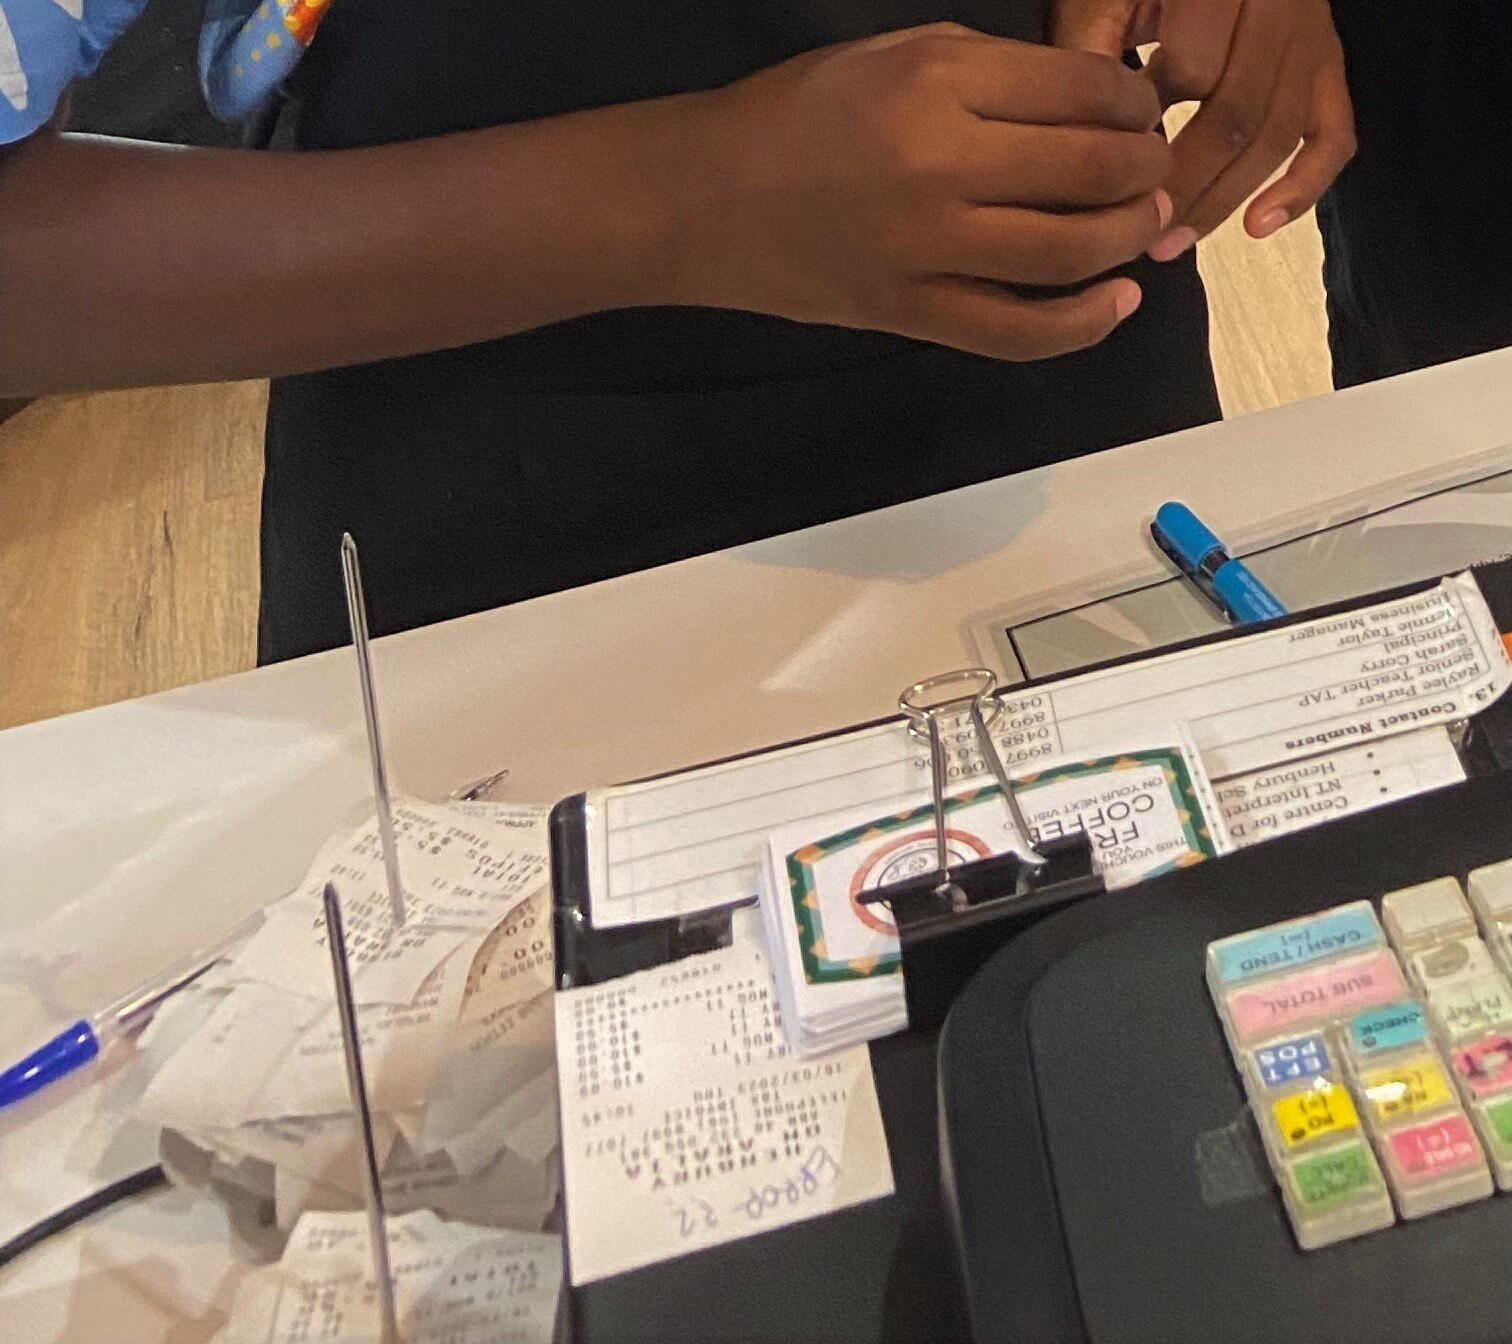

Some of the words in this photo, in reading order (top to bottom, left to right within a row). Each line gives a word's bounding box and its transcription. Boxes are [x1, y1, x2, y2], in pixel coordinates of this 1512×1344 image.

[1287, 618, 1365, 642] Manager
[1339, 622, 1394, 646] Taylor
[1384, 621, 1466, 654] Principal
[1360, 650, 1410, 672] Corry
[1342, 668, 1414, 696] Teacher
[1419, 662, 1480, 690] Raylee
[1298, 690, 1336, 706] TAP
[1356, 682, 1416, 706] Parker
[1380, 702, 1456, 728] Contact
[1286, 724, 1372, 749] Numbers
[1142, 775, 1164, 792] ON
[1254, 762, 1336, 790] Henbury
[1315, 778, 1344, 794] NT
[1064, 795, 1098, 814] NEXT
[1100, 783, 1140, 802] YOUR
[1284, 796, 1349, 820] Centre
[1252, 812, 1278, 830] for
[1154, 835, 1188, 853] THIS
[1304, 927, 1363, 955] CASH
[1238, 946, 1292, 972] TEND
[1328, 973, 1375, 995] SUB
[1264, 986, 1326, 1016] TOTAL
[1358, 1009, 1422, 1038] CHECK
[1256, 1040, 1316, 1068] POS
